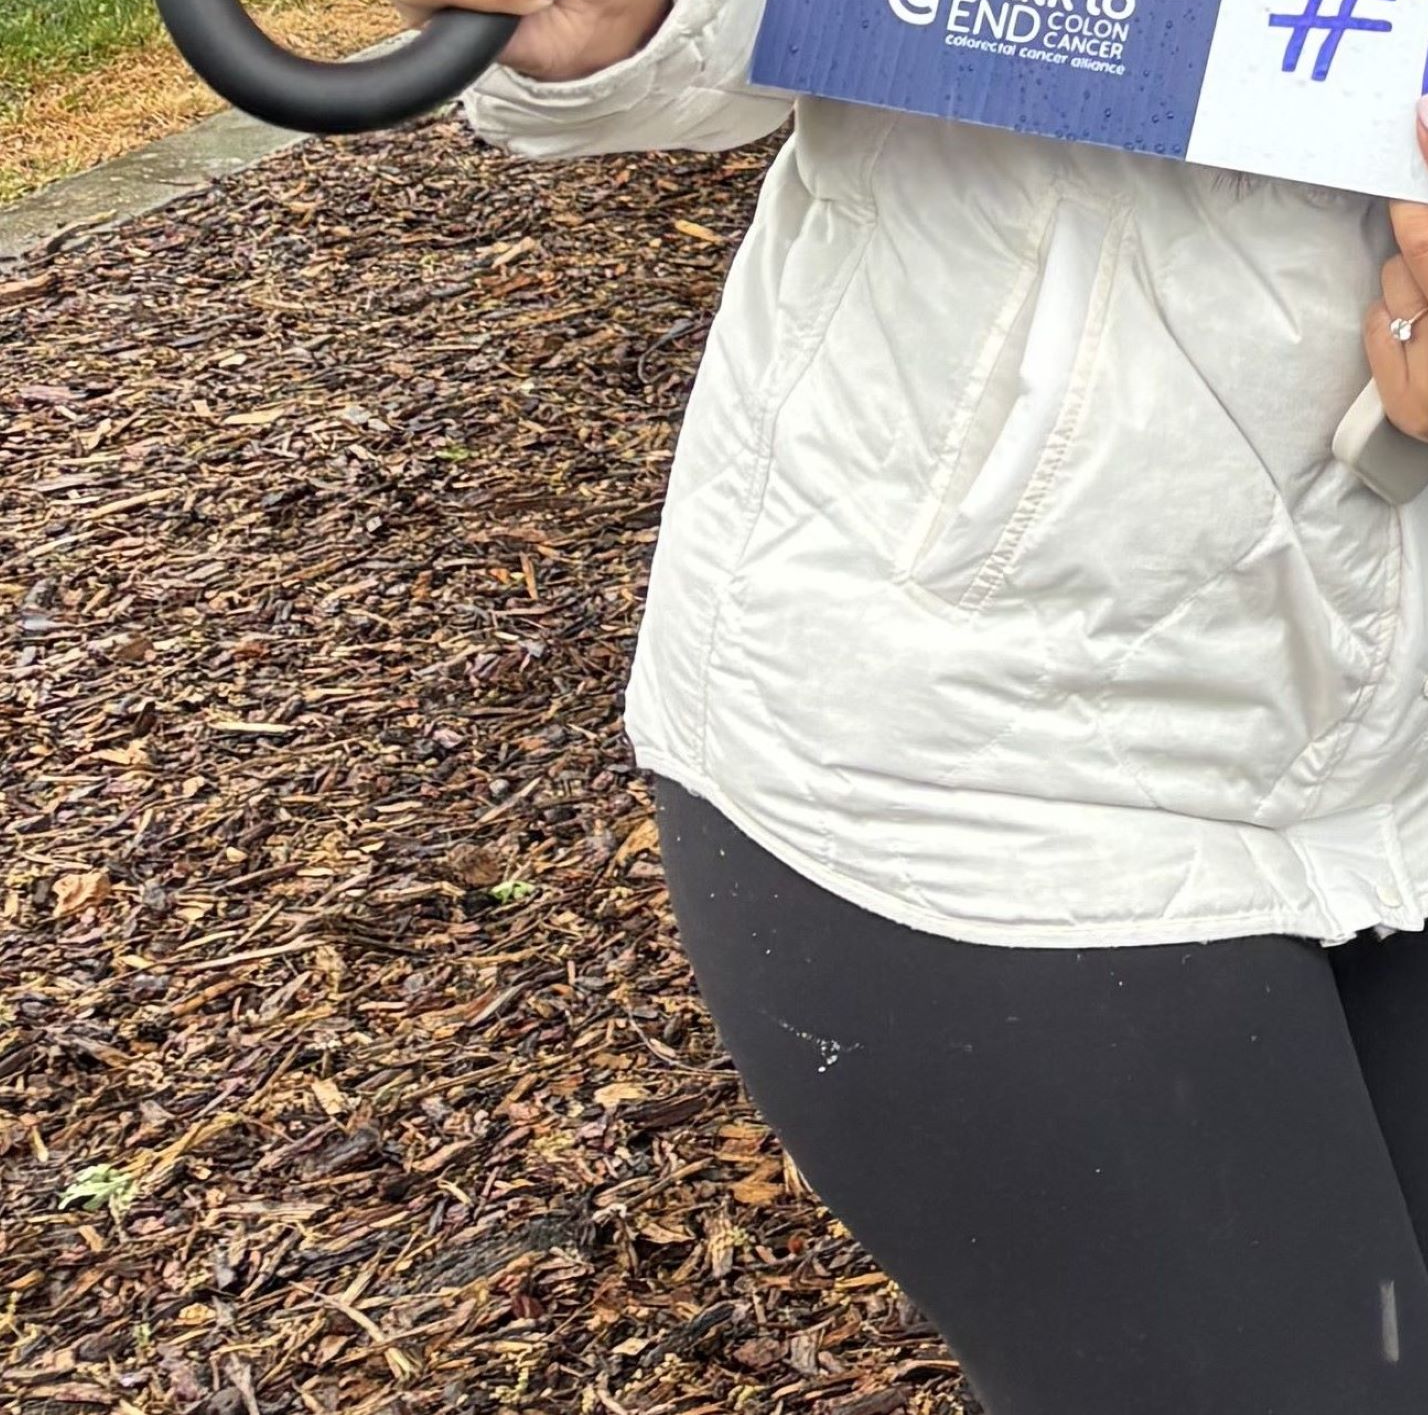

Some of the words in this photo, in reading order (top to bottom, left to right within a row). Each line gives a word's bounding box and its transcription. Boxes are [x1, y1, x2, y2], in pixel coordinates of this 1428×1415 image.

[1047, 11, 1129, 42] COLON
[945, 34, 1016, 56] colorectal
[1019, 47, 1068, 64] cancer
[1071, 56, 1126, 75] alliance
[1043, 32, 1124, 60] CANCER
